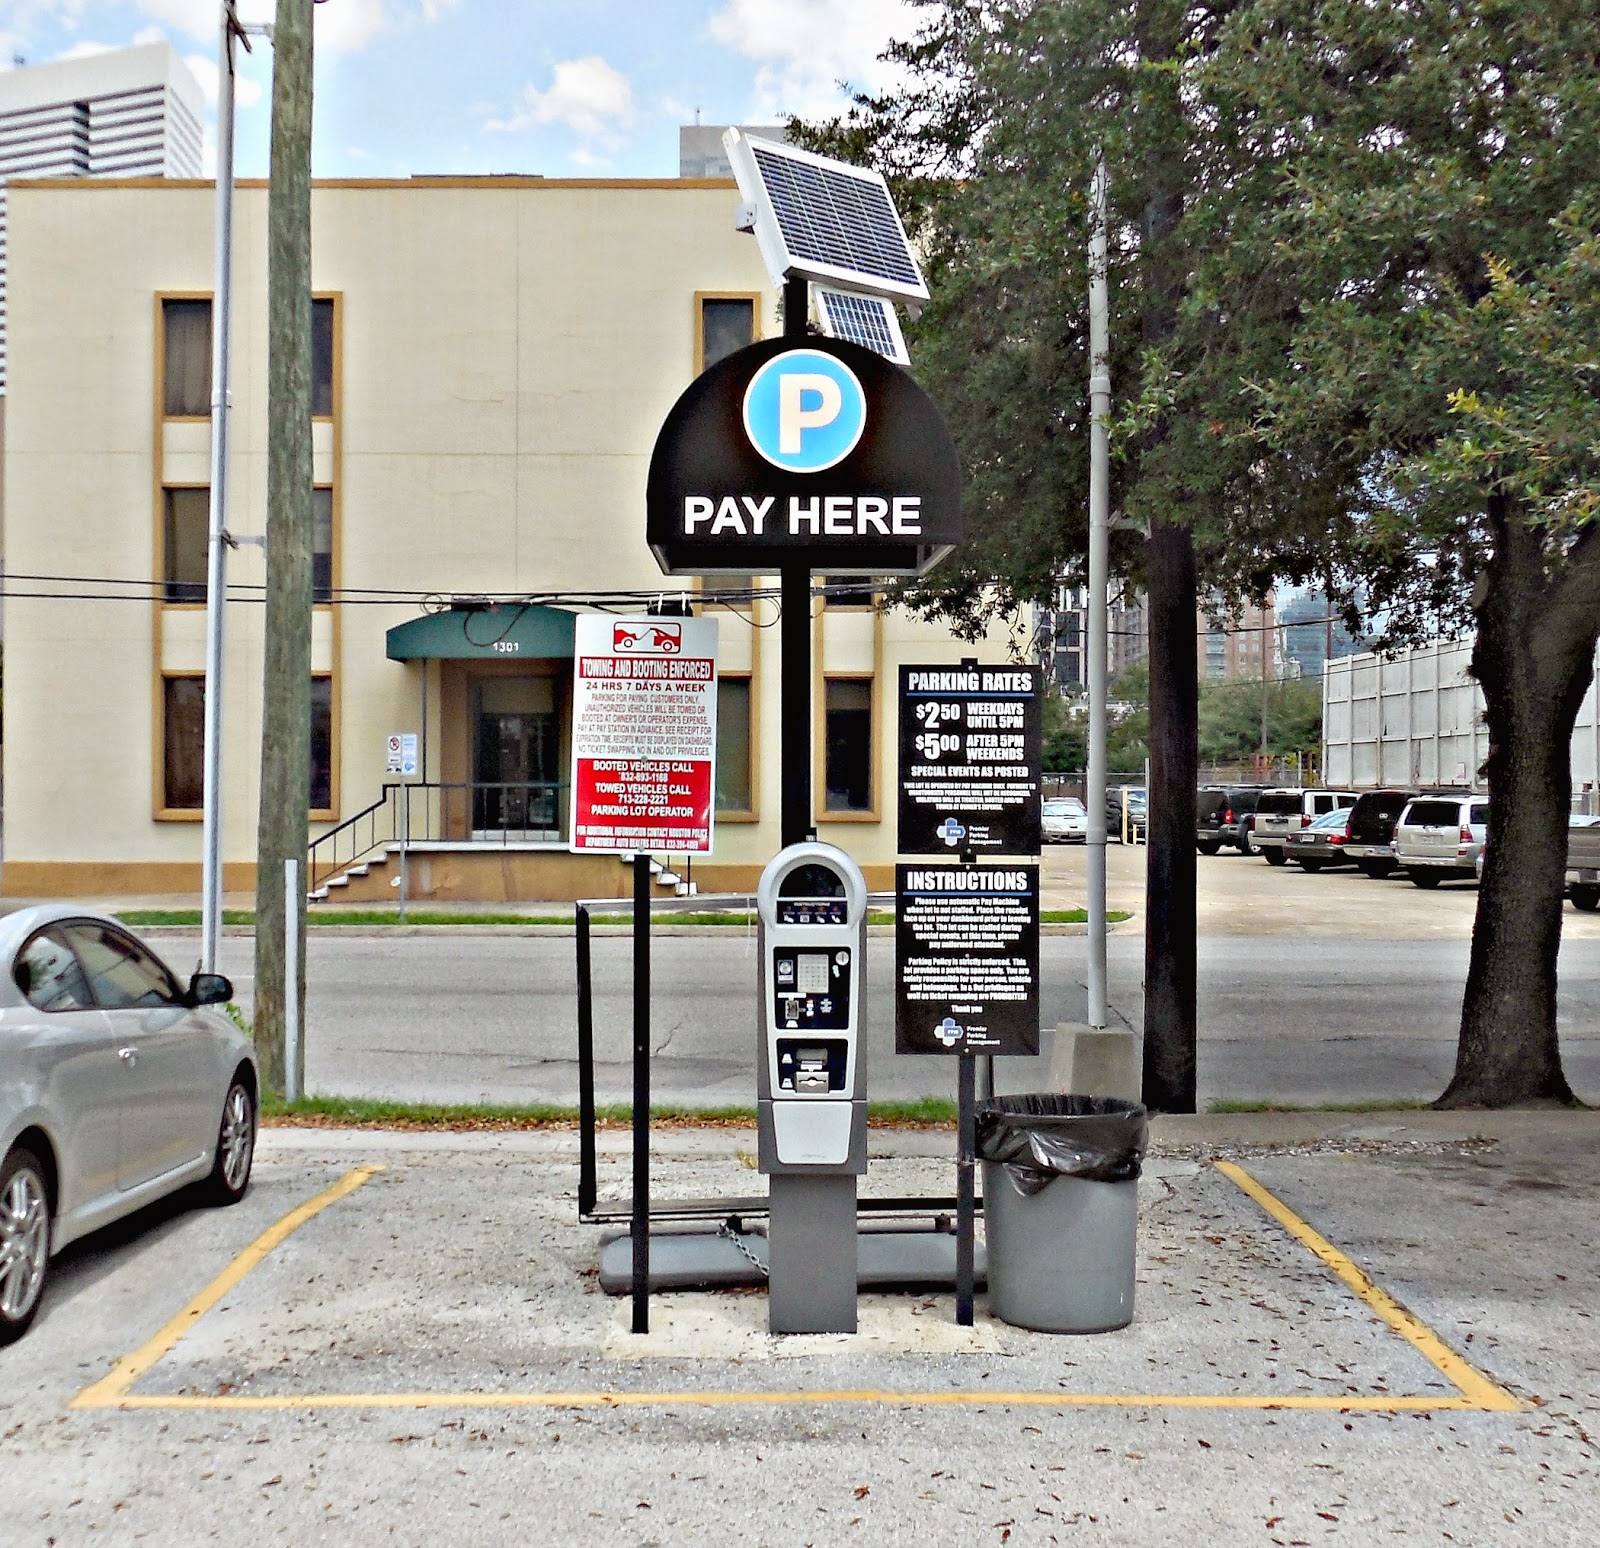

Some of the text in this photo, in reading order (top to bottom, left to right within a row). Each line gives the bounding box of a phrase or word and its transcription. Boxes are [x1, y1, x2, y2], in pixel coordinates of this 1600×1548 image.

[780, 374, 842, 453] P
[684, 496, 922, 535] PAY HERE
[493, 642, 519, 652] 1301
[582, 660, 710, 679] TOWING AND BOOTING ENFORCED
[909, 673, 1032, 691] PARKING RATES
[592, 694, 614, 702] PARKING
[629, 694, 647, 703] PAYING
[651, 695, 682, 703] CUSTOMERS
[685, 696, 698, 704] ONLY.
[967, 703, 1024, 715] WEEKDAYS
[582, 714, 603, 722] BOOTED
[967, 716, 1023, 728] UNTIL 5PM
[665, 726, 675, 734] SEE
[677, 727, 699, 735] RECEIPT
[701, 727, 711, 735] FOR
[966, 735, 1024, 747] AFTER 5PM
[607, 746, 635, 754] SWAPPING.
[665, 747, 676, 755] OUT
[678, 747, 709, 756] PRIVILEGES.
[966, 748, 1023, 760] WEEKENDS
[593, 761, 693, 773] BOOTED VEHICLES CALL
[911, 766, 1028, 777] SPECIAL EVENTS AS POSTED
[595, 783, 691, 795] TOWED VEHICLES CALL
[591, 806, 693, 817] PARKING LOT OPERATOR
[907, 872, 1027, 890] INSTRUCTIONS
